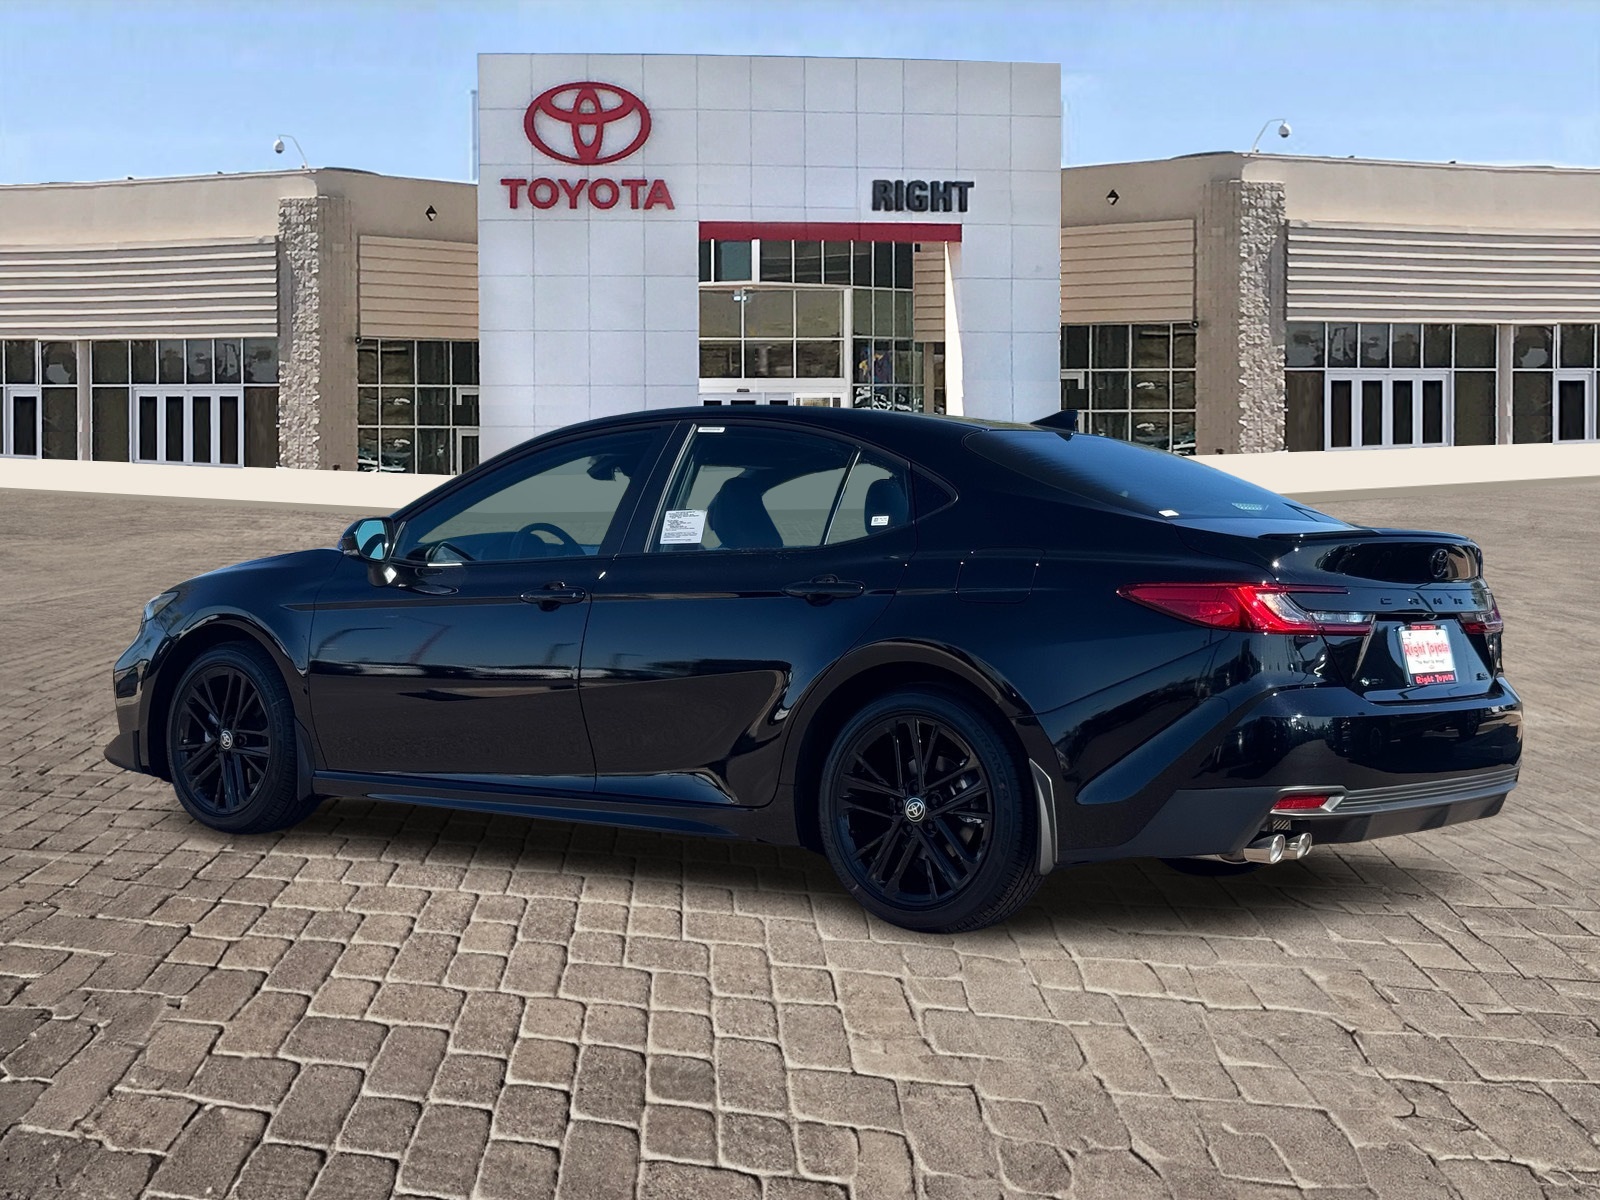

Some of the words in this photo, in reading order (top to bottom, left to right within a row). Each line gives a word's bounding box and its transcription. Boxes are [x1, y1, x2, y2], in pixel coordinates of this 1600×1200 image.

[500, 177, 676, 210] TOYOTA
[872, 179, 975, 213] RIGHT
[1404, 642, 1426, 657] Right
[1426, 642, 1449, 657] Toyota
[1416, 674, 1434, 685] Right
[1435, 673, 1455, 683] Toyota
